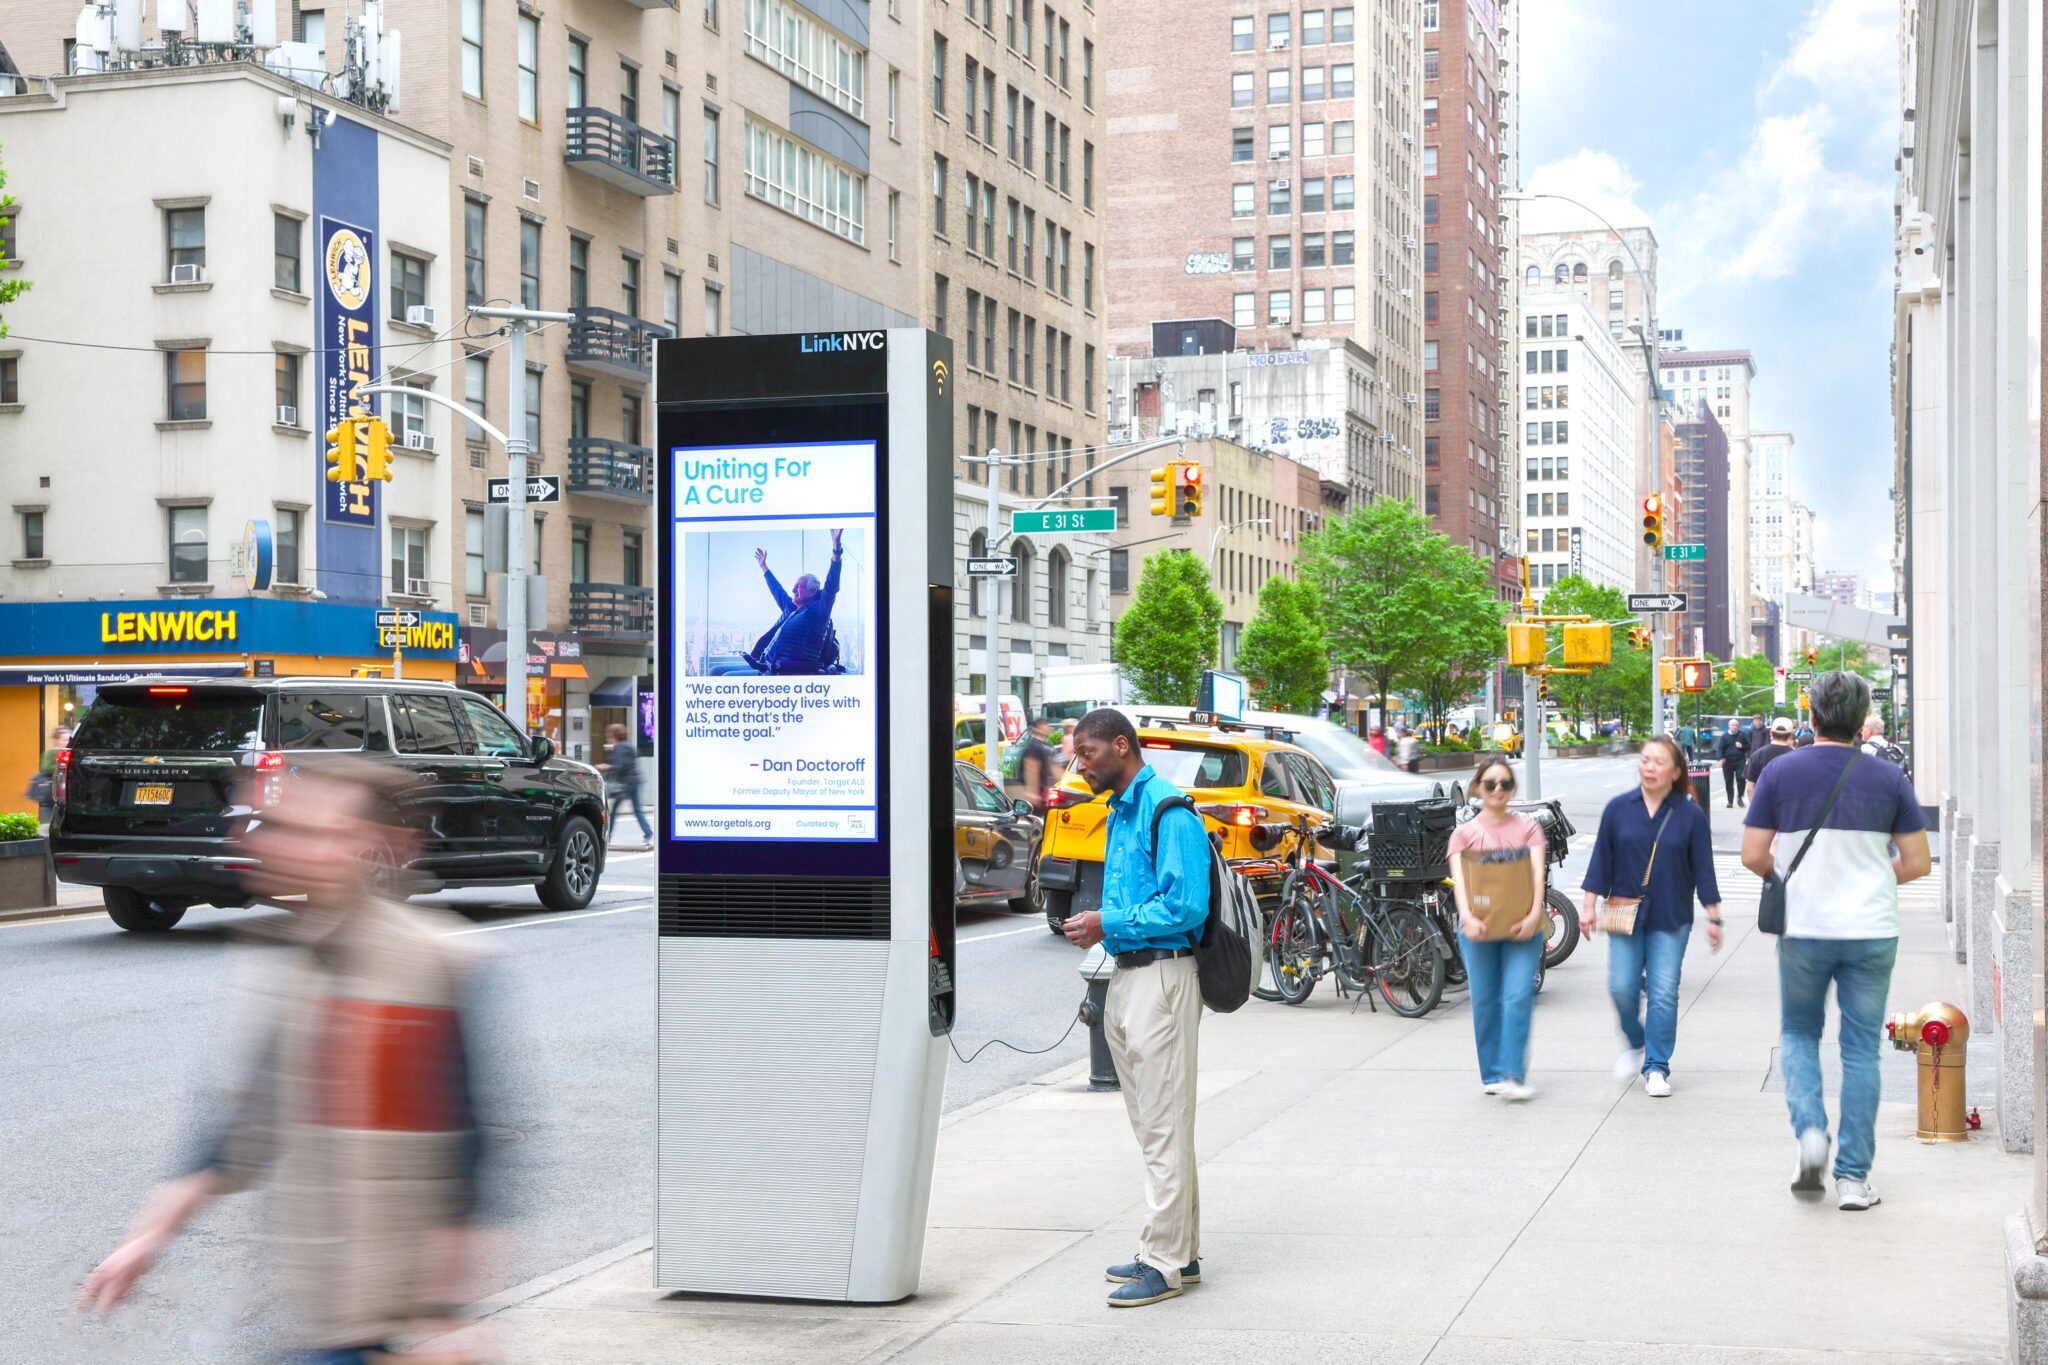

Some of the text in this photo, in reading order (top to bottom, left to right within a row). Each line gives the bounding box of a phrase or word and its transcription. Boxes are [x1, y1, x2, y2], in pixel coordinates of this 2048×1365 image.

[338, 314, 346, 346] New
[800, 331, 884, 353] LinkNYC
[338, 348, 347, 386] York's
[329, 377, 338, 413] Since
[684, 457, 811, 485] Uniting For
[527, 484, 548, 495] WAY
[684, 484, 764, 505] A Cure
[1043, 514, 1085, 528] E 31 St
[1671, 547, 1676, 558] E
[1680, 546, 1688, 558] 31
[1634, 599, 1677, 607] ONE WAY
[101, 609, 236, 643] LENWICH
[27, 674, 43, 682] New
[43, 674, 65, 682] York's
[66, 674, 96, 682] Ultimate
[715, 685, 740, 694] can
[743, 682, 791, 694] foresee
[794, 685, 802, 694] a
[805, 682, 830, 697] day
[686, 696, 861, 712] where everybody lives with
[686, 712, 804, 725] ALS, and that's the
[686, 726, 740, 737] ultimate
[763, 759, 792, 771] Dan
[796, 758, 865, 772] Doctoroff
[787, 778, 865, 788] Founder, Target ALS
[733, 787, 865, 797] Former Deputy Mayor of New York
[685, 818, 839, 831] www.targetals.org Curated by
